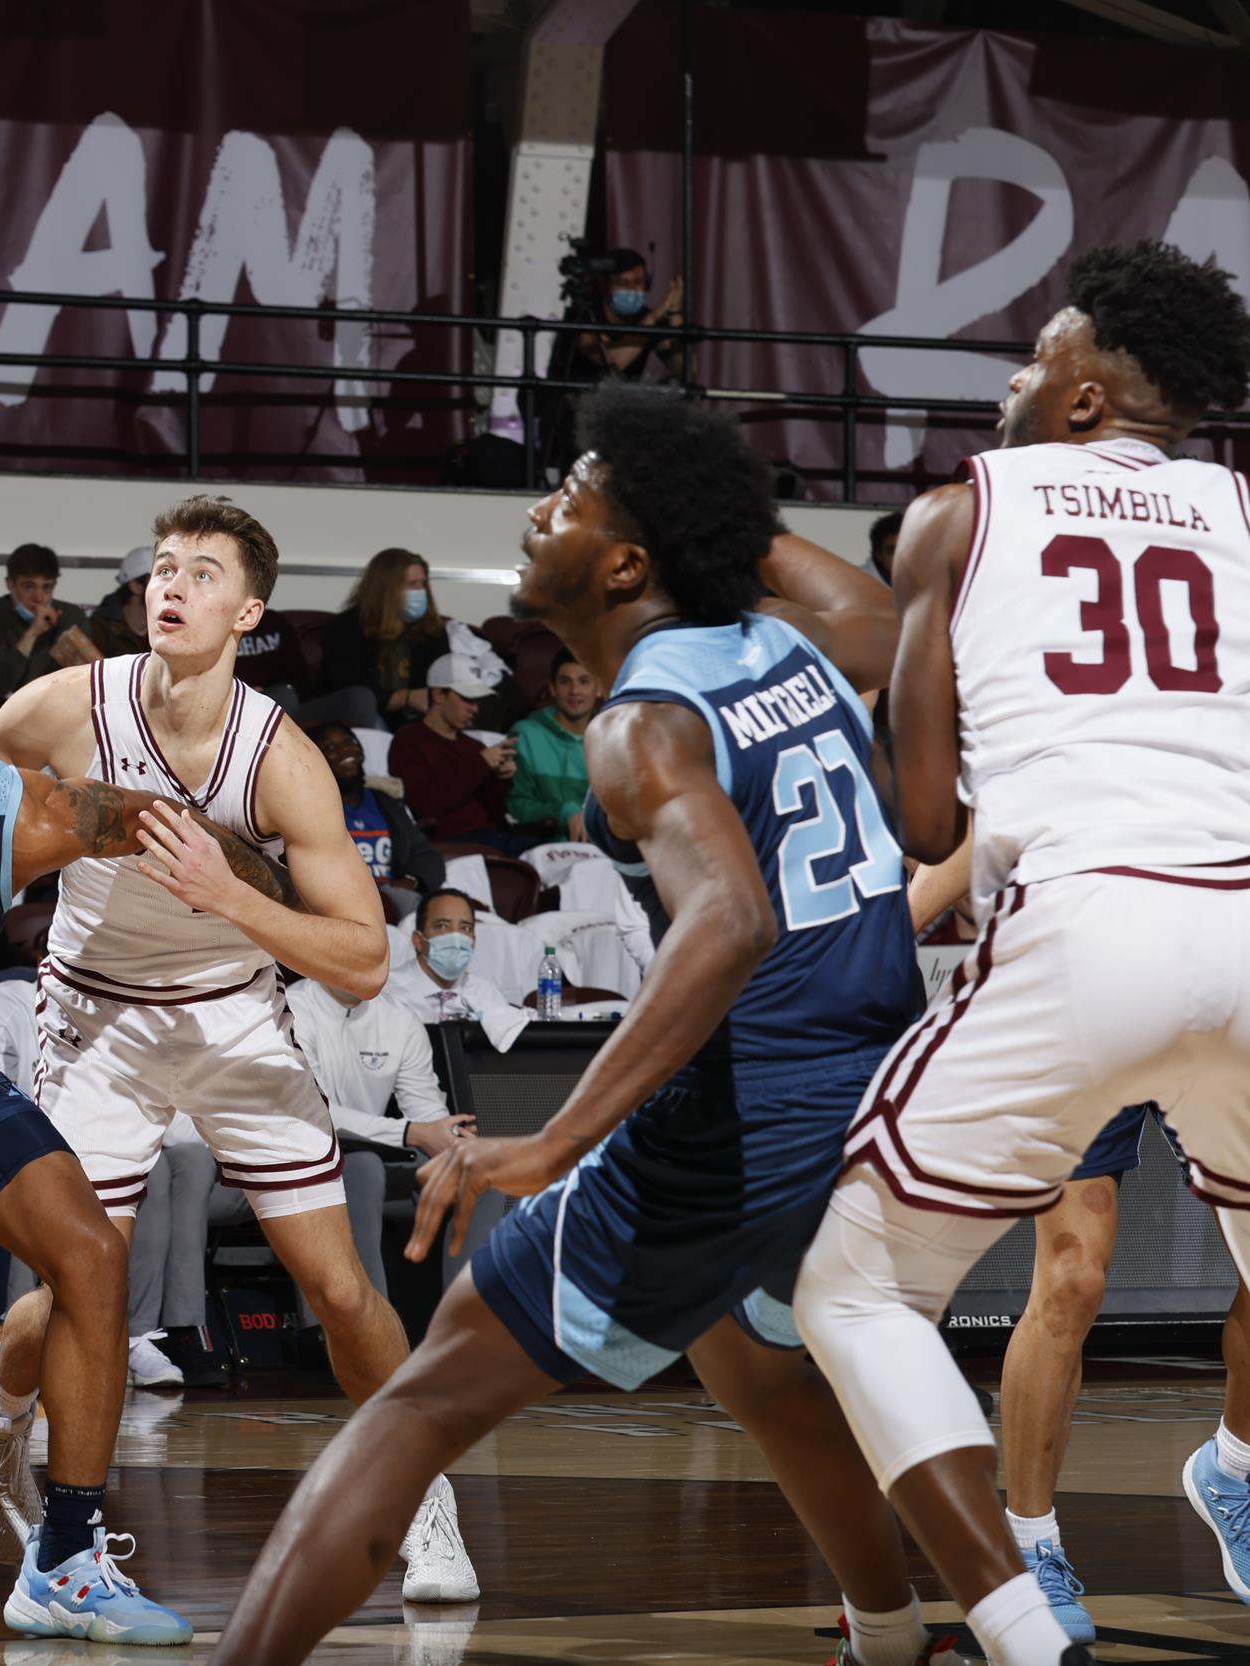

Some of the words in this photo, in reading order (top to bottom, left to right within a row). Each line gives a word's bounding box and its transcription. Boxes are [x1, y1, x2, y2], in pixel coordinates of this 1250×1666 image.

[1033, 484, 1211, 533] TSIMBILA
[1041, 534, 1223, 695] 30
[772, 728, 903, 931] 21
